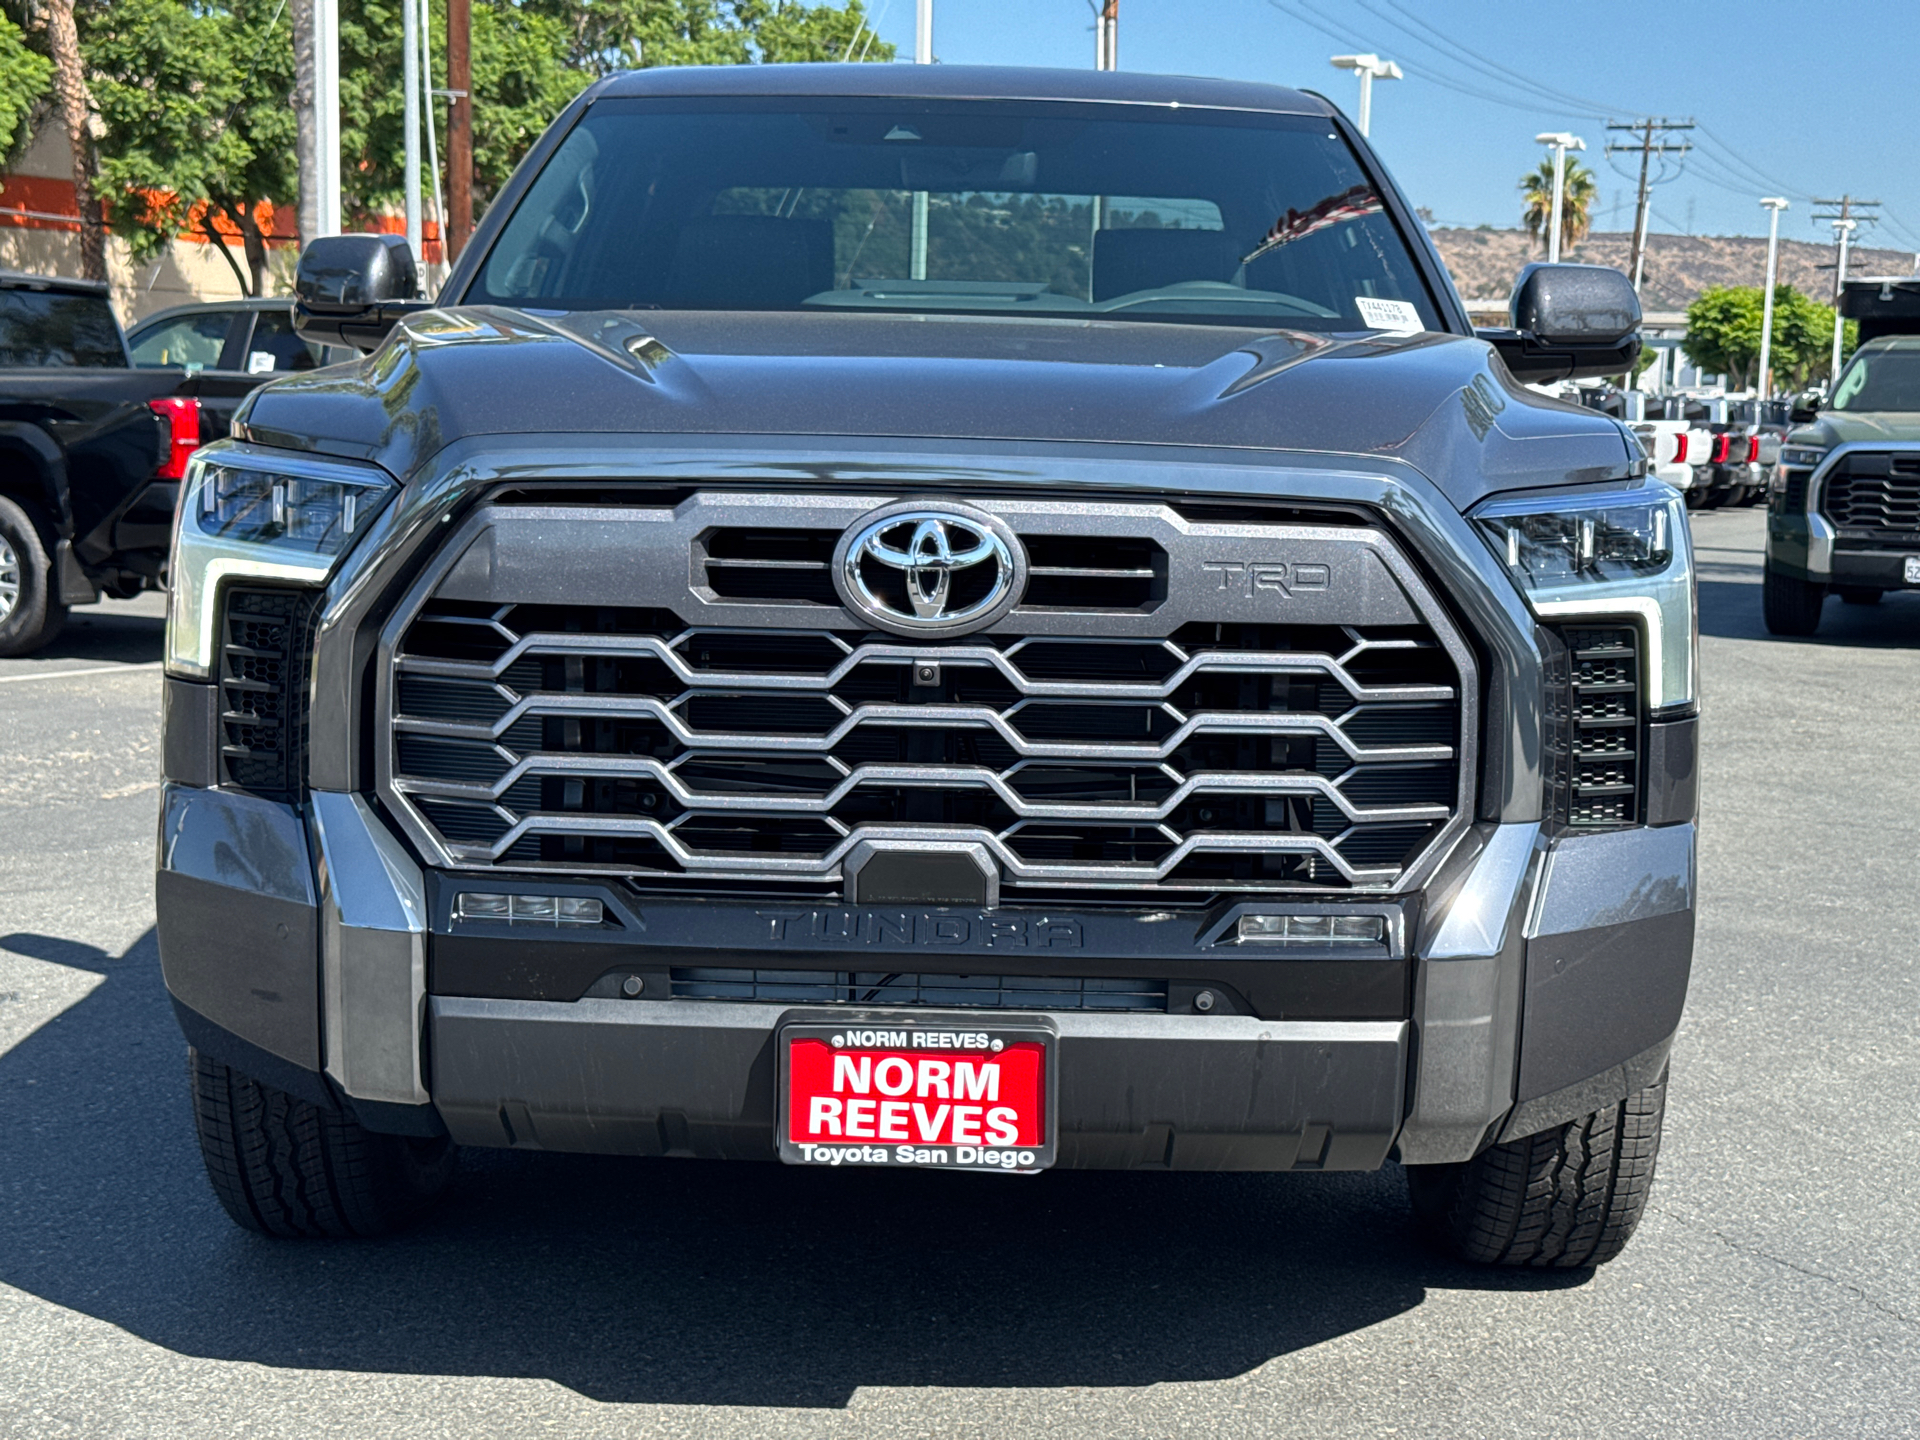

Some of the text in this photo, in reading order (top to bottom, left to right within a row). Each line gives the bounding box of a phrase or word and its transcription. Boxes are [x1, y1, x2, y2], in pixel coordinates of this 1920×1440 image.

[1202, 561, 1331, 599] TRD
[755, 910, 1084, 948] TUNDRA
[846, 1031, 989, 1050] NORM REEVES
[832, 1055, 1000, 1101] NORM
[808, 1096, 1019, 1146] REEVES
[798, 1143, 1035, 1169] Toyota San Diego
